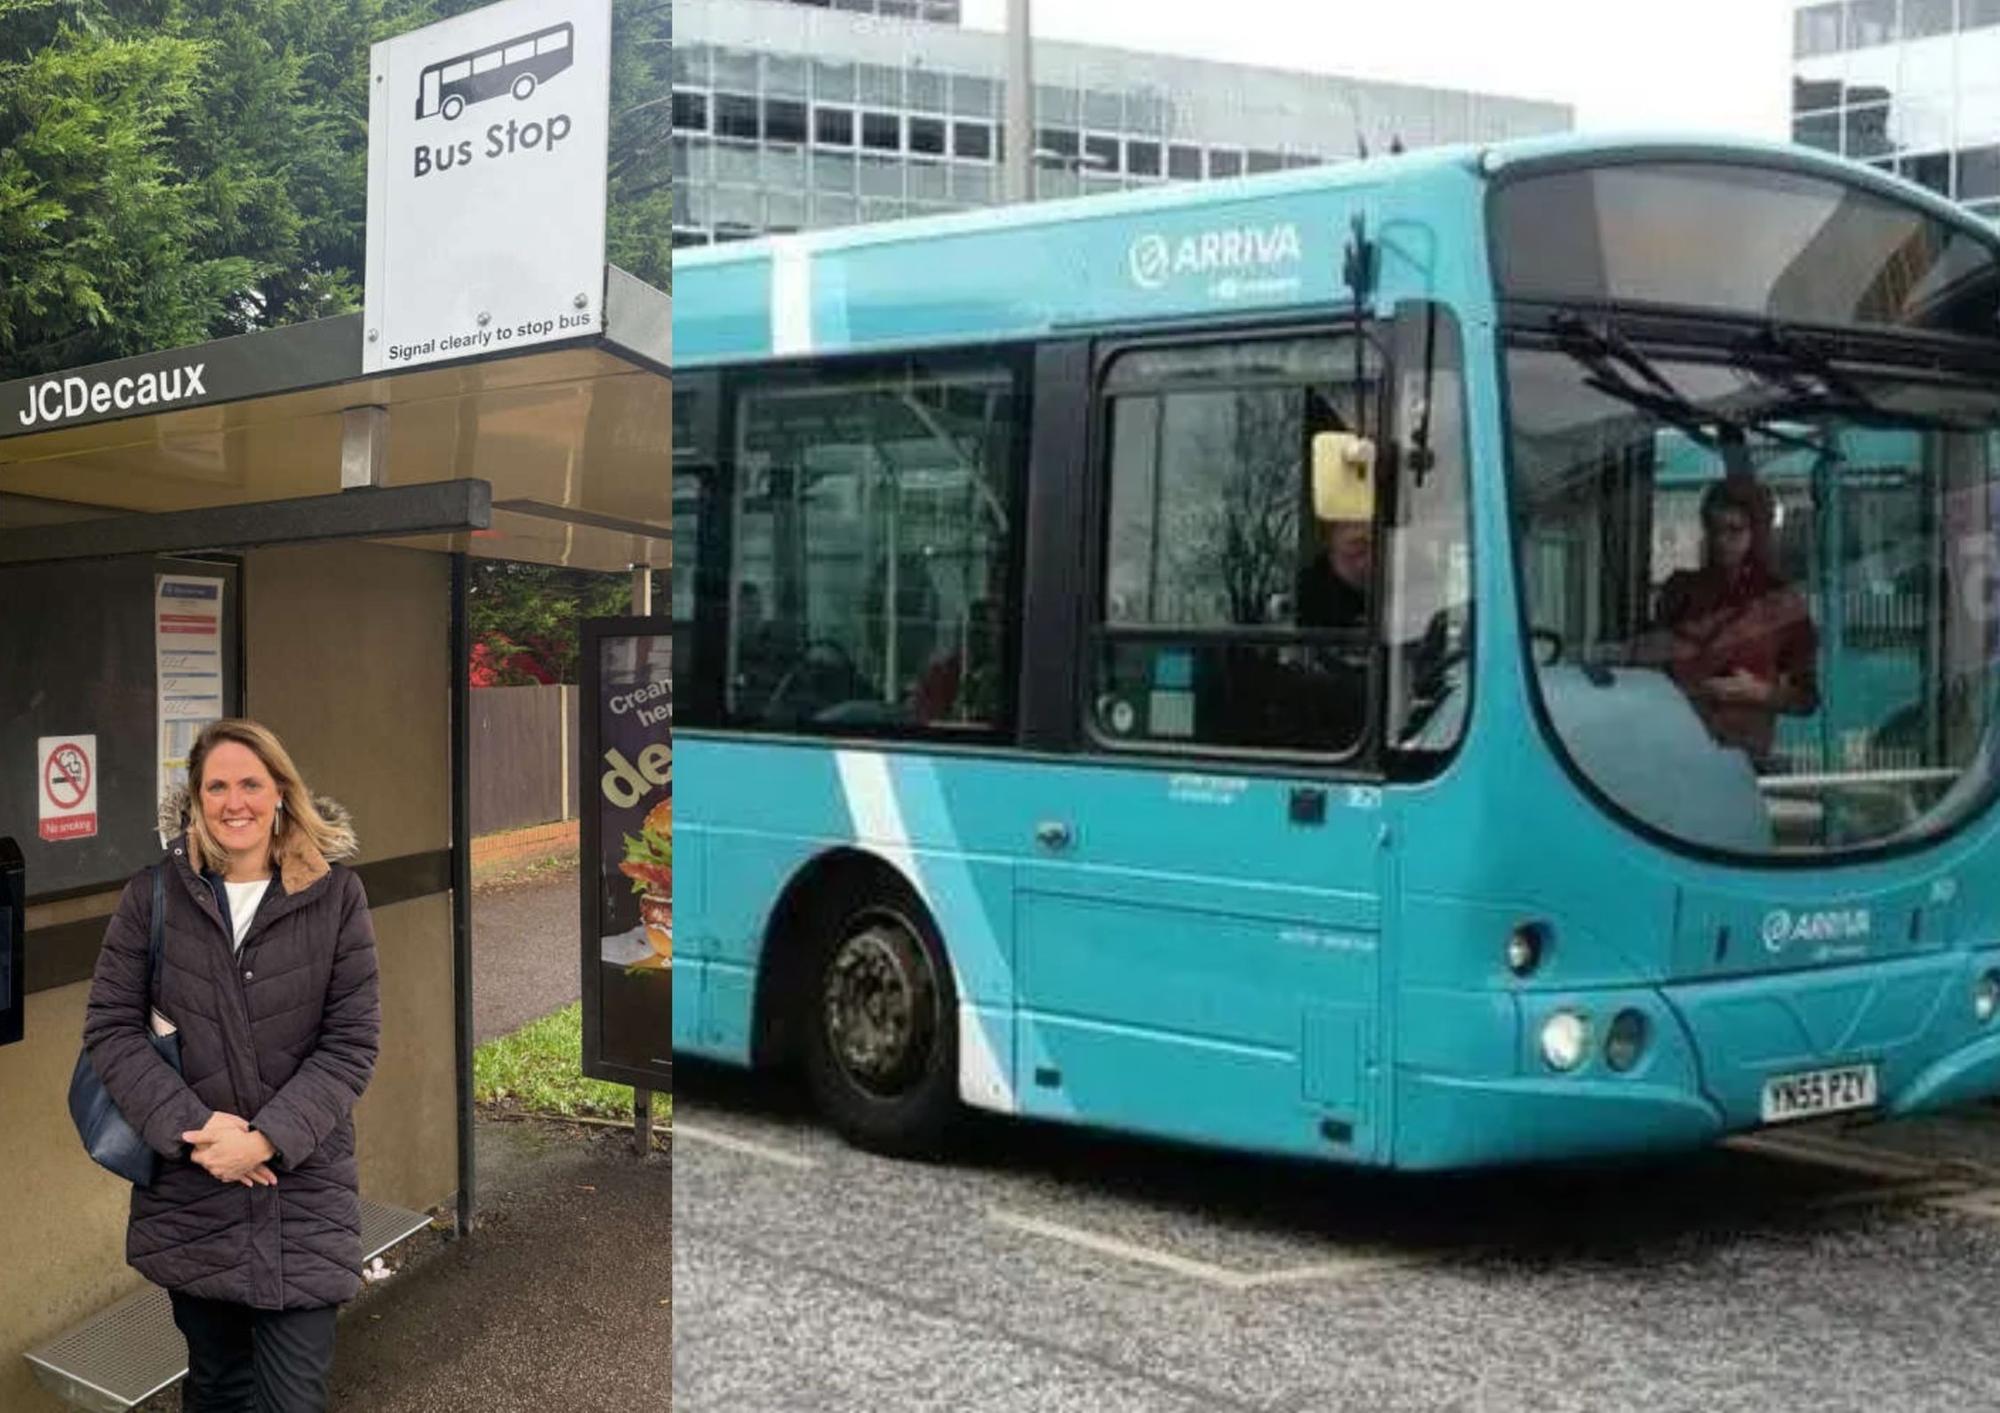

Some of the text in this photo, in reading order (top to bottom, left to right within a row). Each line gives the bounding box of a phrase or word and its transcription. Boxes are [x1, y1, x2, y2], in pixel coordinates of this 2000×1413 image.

[414, 114, 572, 177] Bus Stop
[1174, 223, 1300, 274] ARRIVA
[388, 312, 591, 361] Signal clearly to stop bus
[19, 363, 207, 426] JCDecaux
